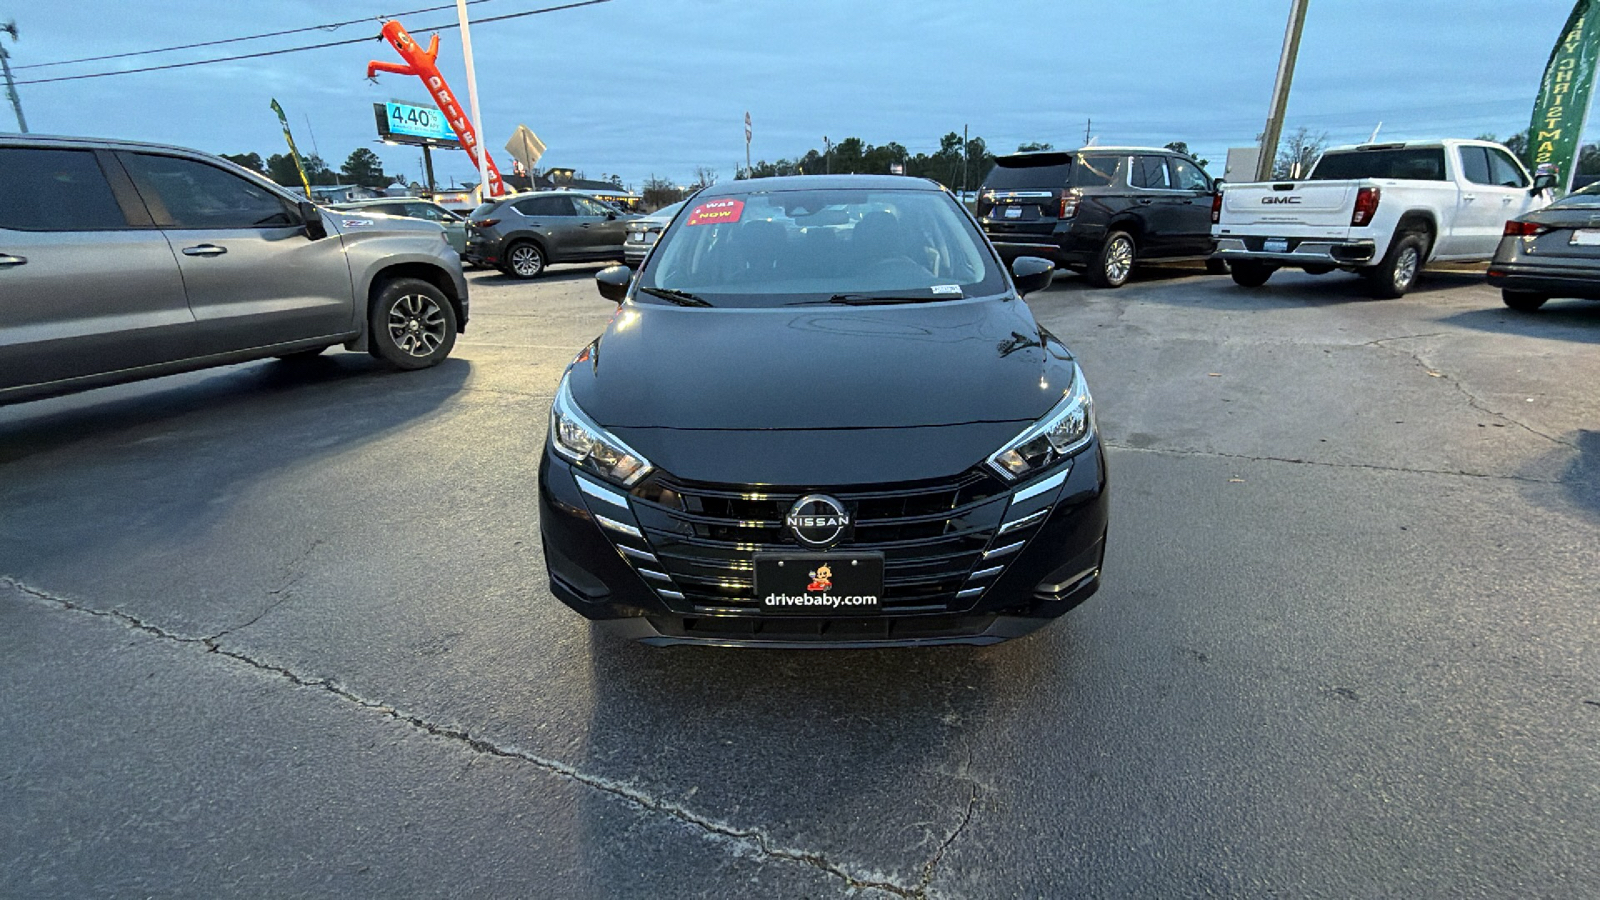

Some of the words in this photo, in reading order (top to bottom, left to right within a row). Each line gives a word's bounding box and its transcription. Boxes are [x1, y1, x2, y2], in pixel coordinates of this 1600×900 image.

[1261, 196, 1302, 204] GMC
[699, 211, 731, 219] NOW
[787, 516, 849, 527] NISSAN
[764, 593, 877, 608] drivebaby.com
